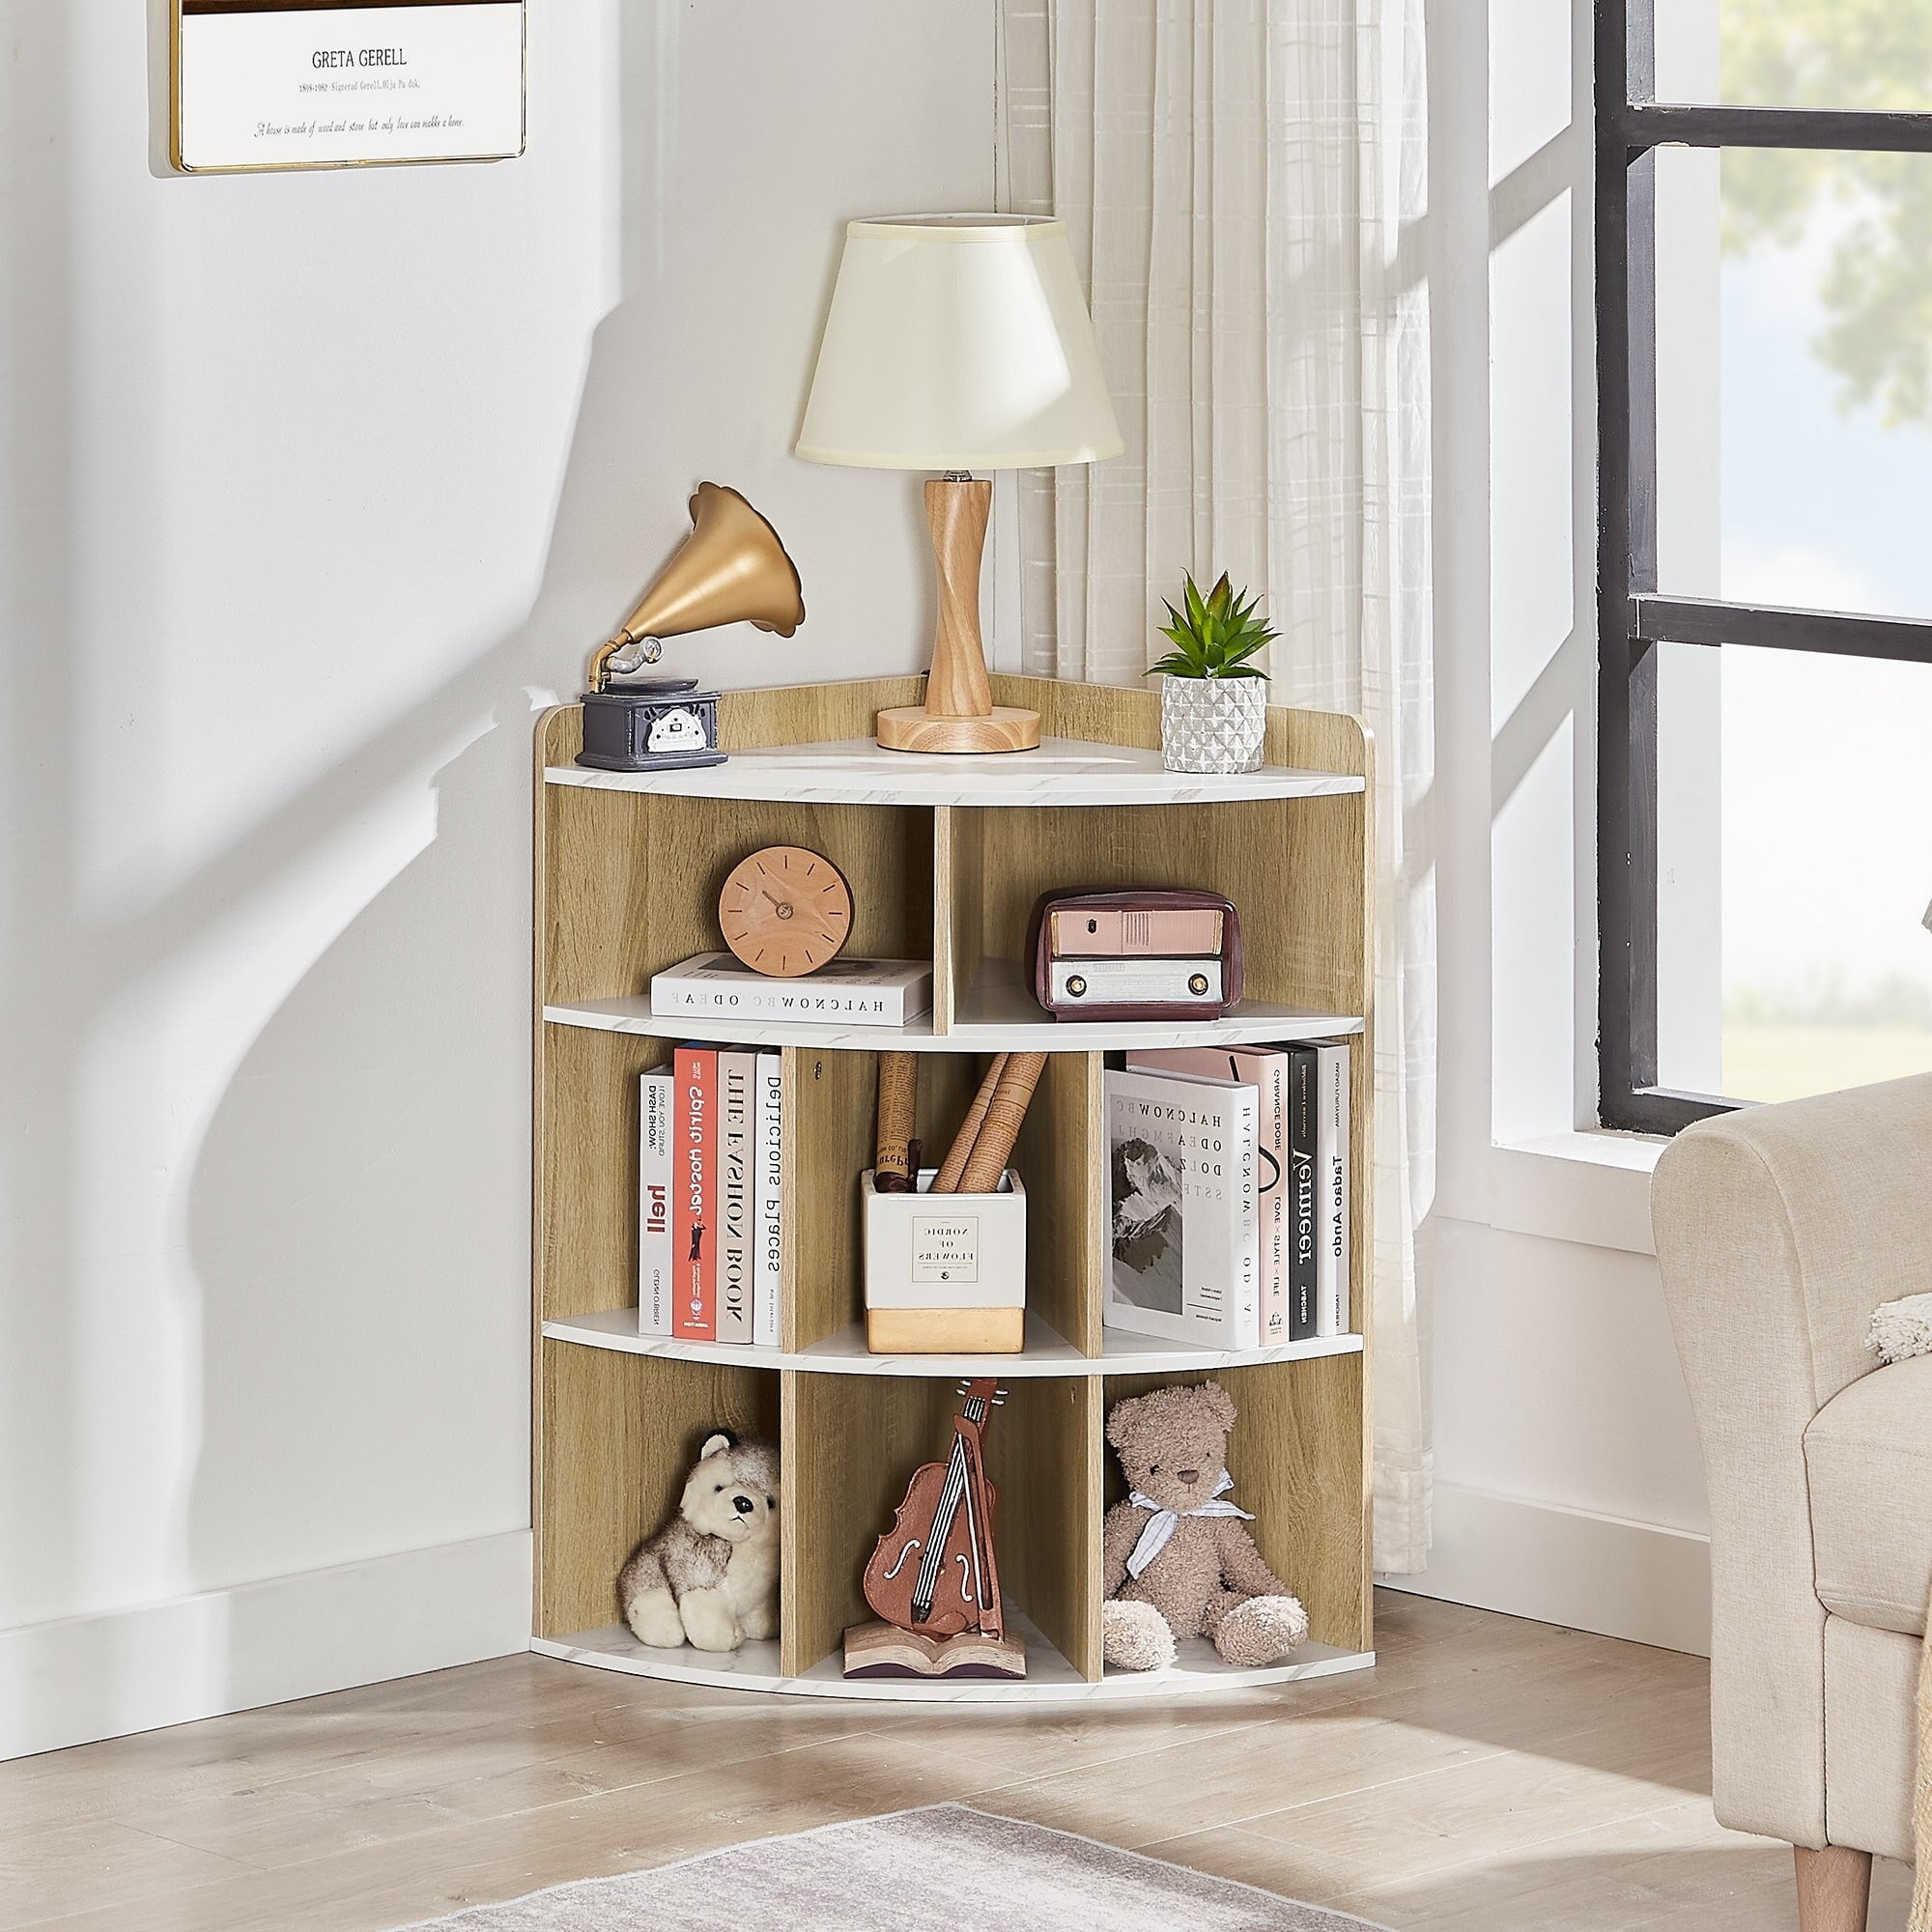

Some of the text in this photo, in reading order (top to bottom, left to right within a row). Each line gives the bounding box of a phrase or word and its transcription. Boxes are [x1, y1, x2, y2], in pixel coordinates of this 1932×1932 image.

[312, 48, 407, 69] GRETA GERELL
[292, 122, 306, 133] made
[308, 120, 317, 137] of
[334, 120, 347, 131] and
[368, 118, 378, 130] but
